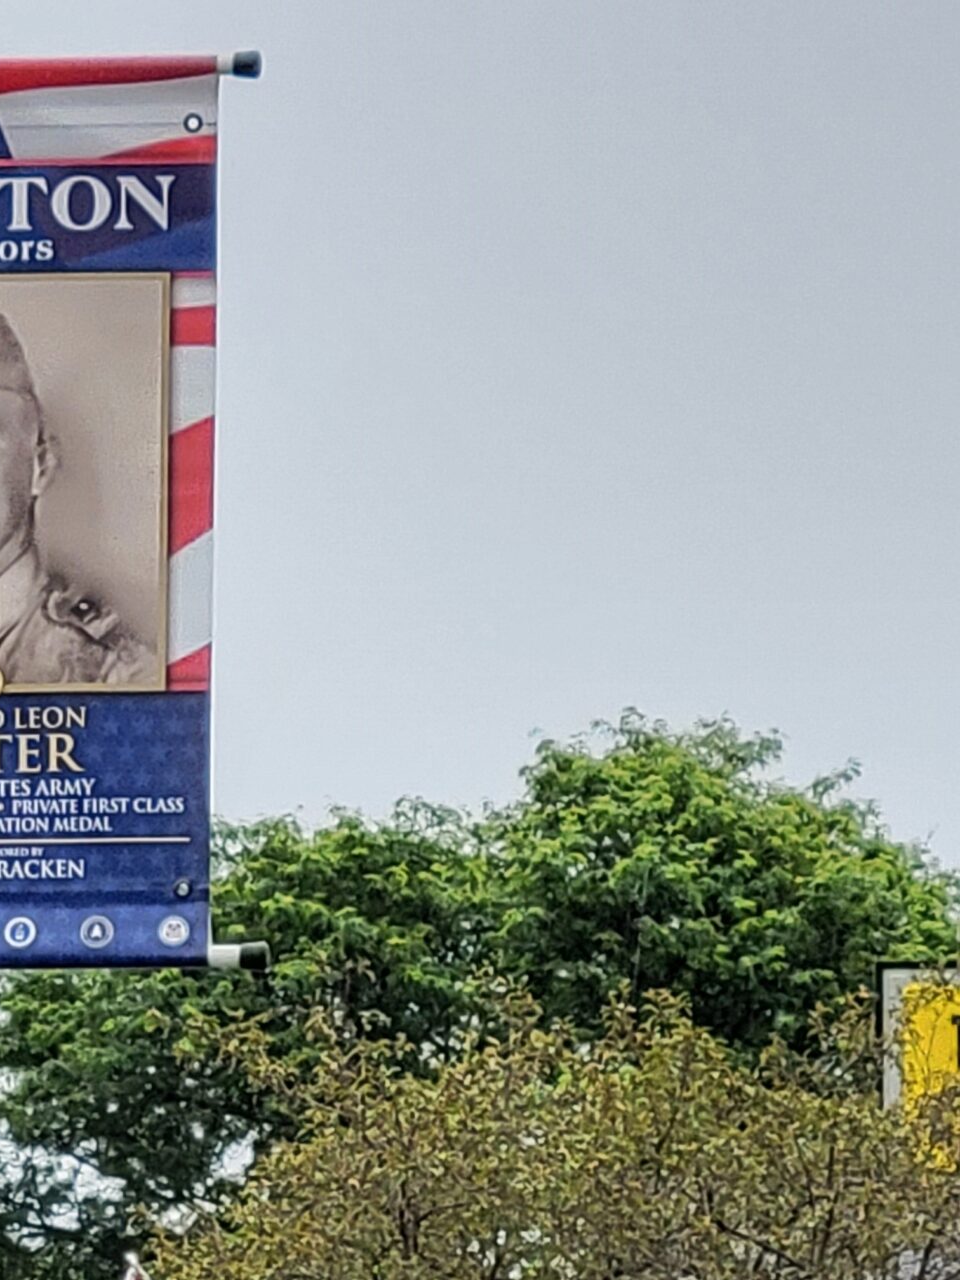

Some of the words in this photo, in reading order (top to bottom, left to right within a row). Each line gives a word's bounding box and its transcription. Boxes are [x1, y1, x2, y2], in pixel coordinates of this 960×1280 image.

[14, 706, 87, 730] LEON
[35, 778, 96, 797] ARMY
[11, 799, 79, 815] PRIVATE
[83, 798, 130, 814] FIRST
[133, 797, 185, 813] CLASS
[53, 816, 113, 833] MEDAL
